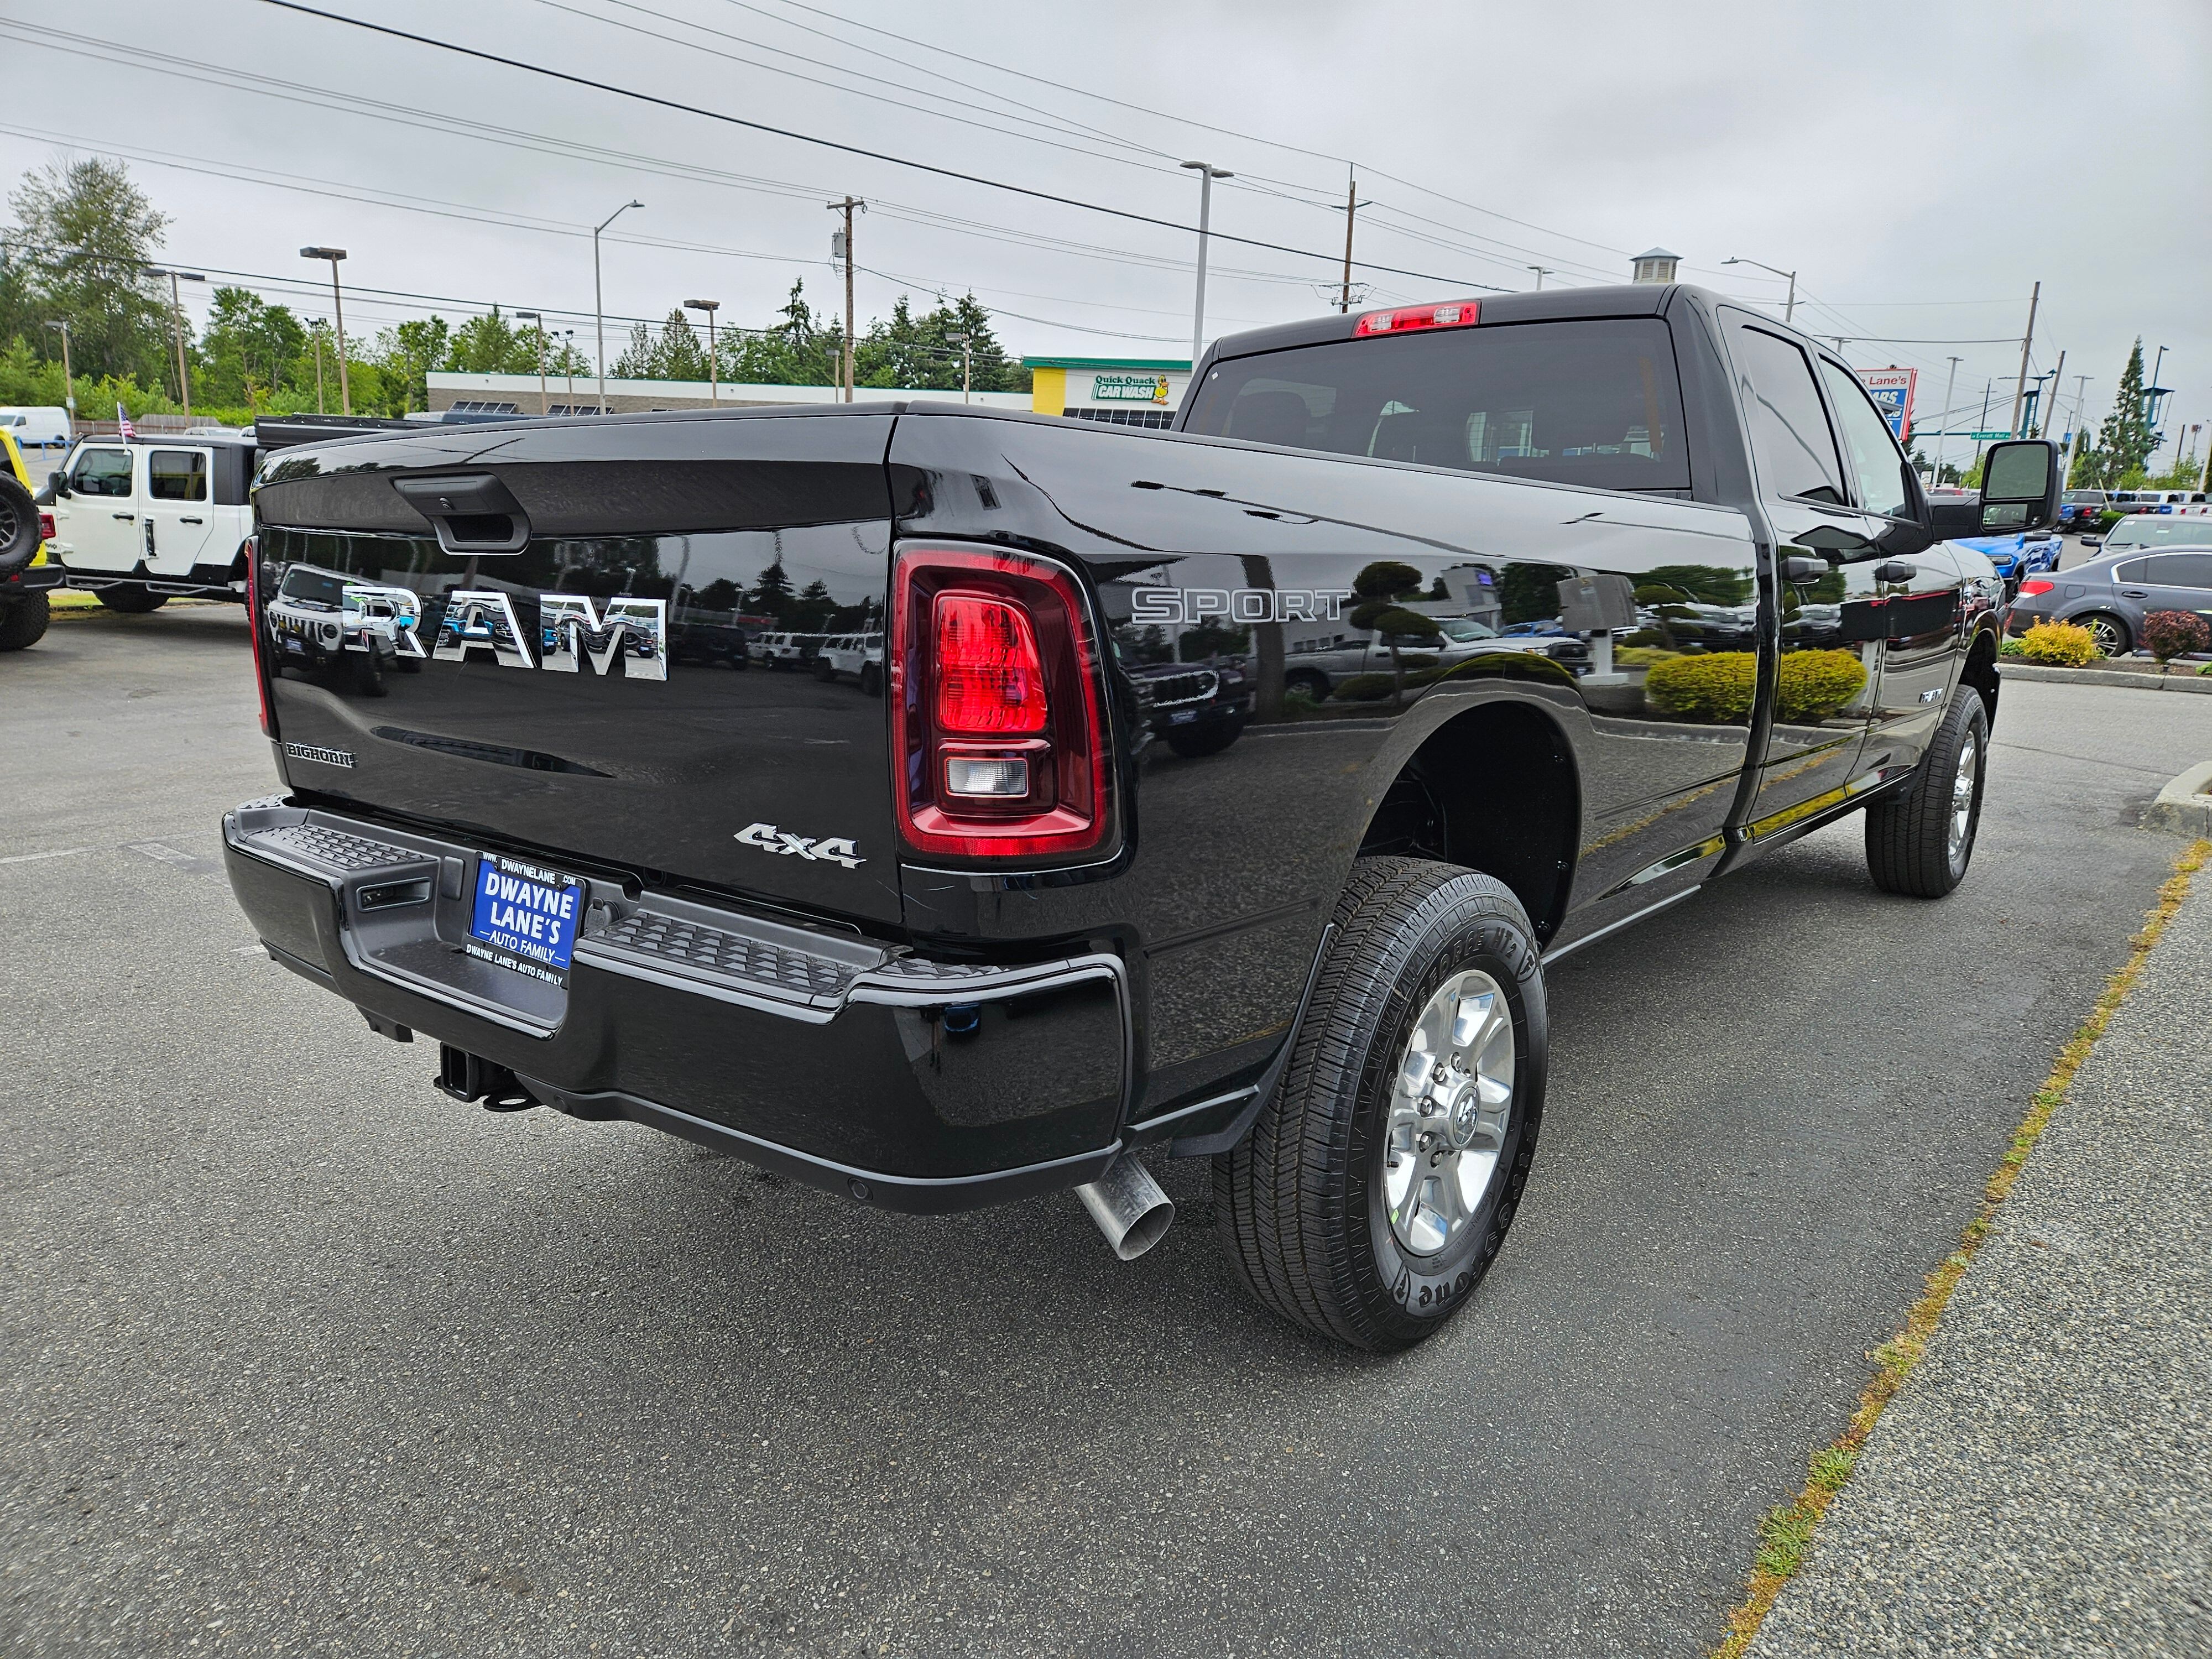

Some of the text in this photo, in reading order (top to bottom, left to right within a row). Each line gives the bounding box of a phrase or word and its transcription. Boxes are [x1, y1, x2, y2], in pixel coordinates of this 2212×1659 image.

[1095, 375, 1155, 385] Quick Quack
[1098, 385, 1155, 399] CAR WASH
[1870, 376, 1907, 385] Lane's
[1131, 587, 1351, 625] SPORT
[342, 585, 669, 681] RAM
[285, 742, 354, 769] BIGHORN
[501, 859, 556, 884] DWAYNELANE
[484, 872, 574, 920] DWAYNE
[490, 901, 561, 945] LANE'S
[489, 930, 556, 963] AUTO FAMILY
[466, 943, 564, 987] DWAYNE LANE'S AUTO FAMILY
